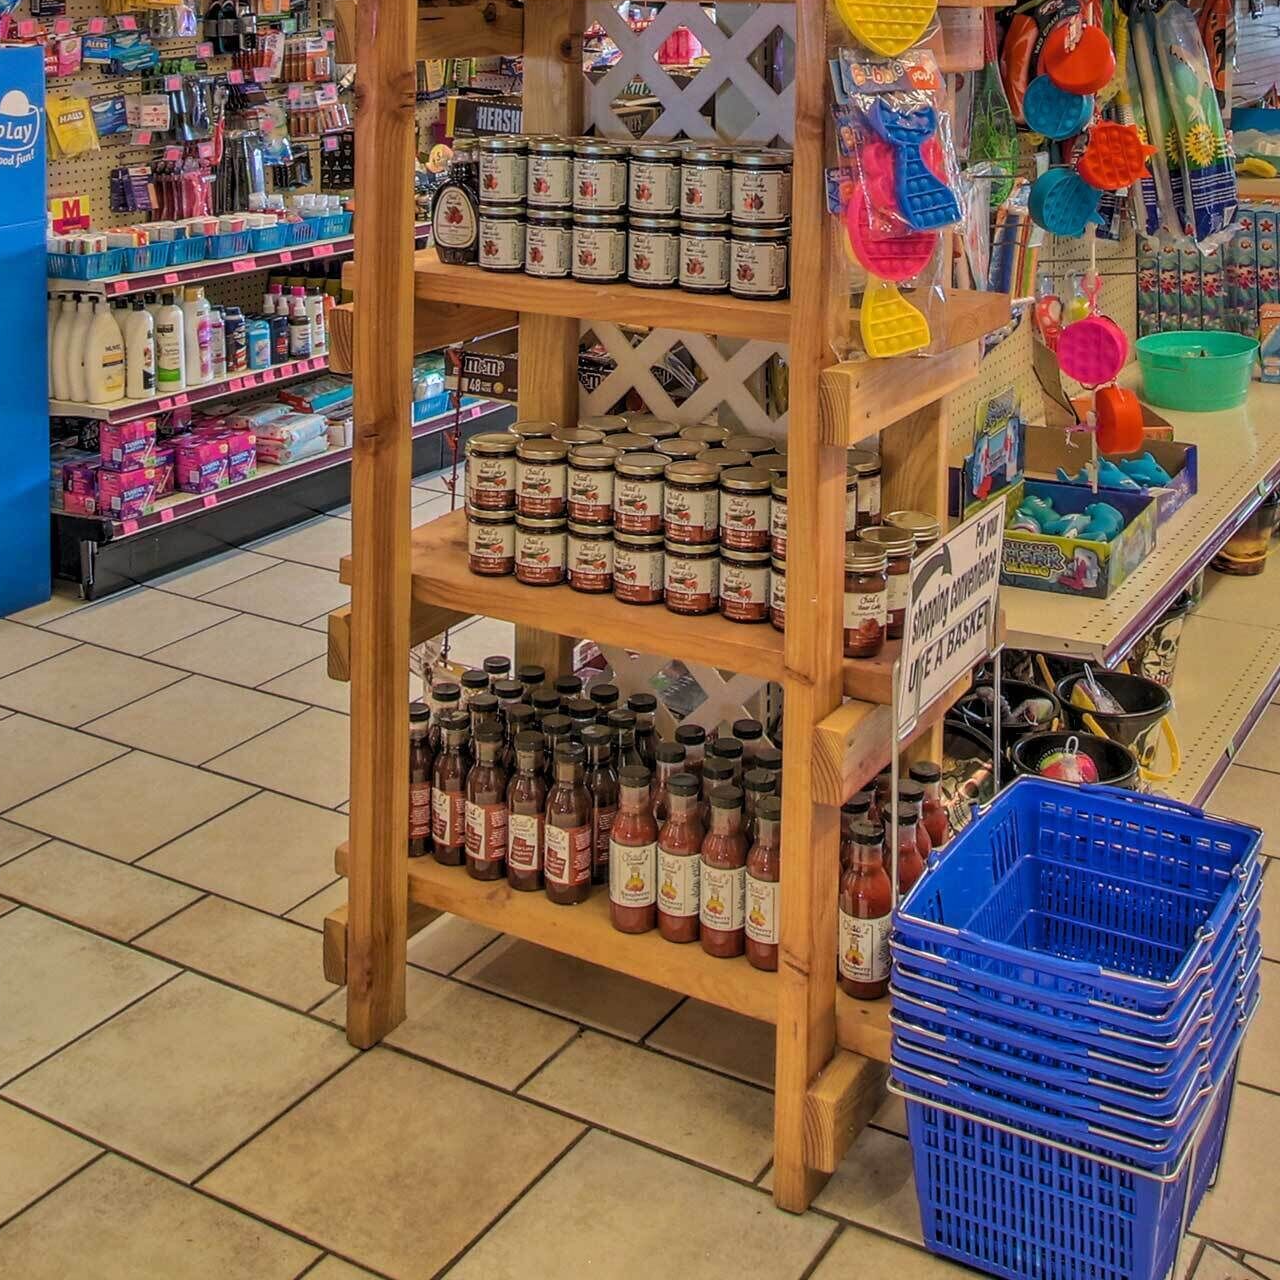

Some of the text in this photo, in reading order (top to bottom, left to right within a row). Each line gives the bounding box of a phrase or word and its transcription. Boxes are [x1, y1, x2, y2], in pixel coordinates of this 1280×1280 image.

[477, 106, 521, 134] HERSH
[15, 148, 35, 168] fun!
[469, 377, 481, 392] 48
[950, 549, 997, 613] convenience
[935, 644, 944, 667] A
[946, 606, 988, 658] BASKET
